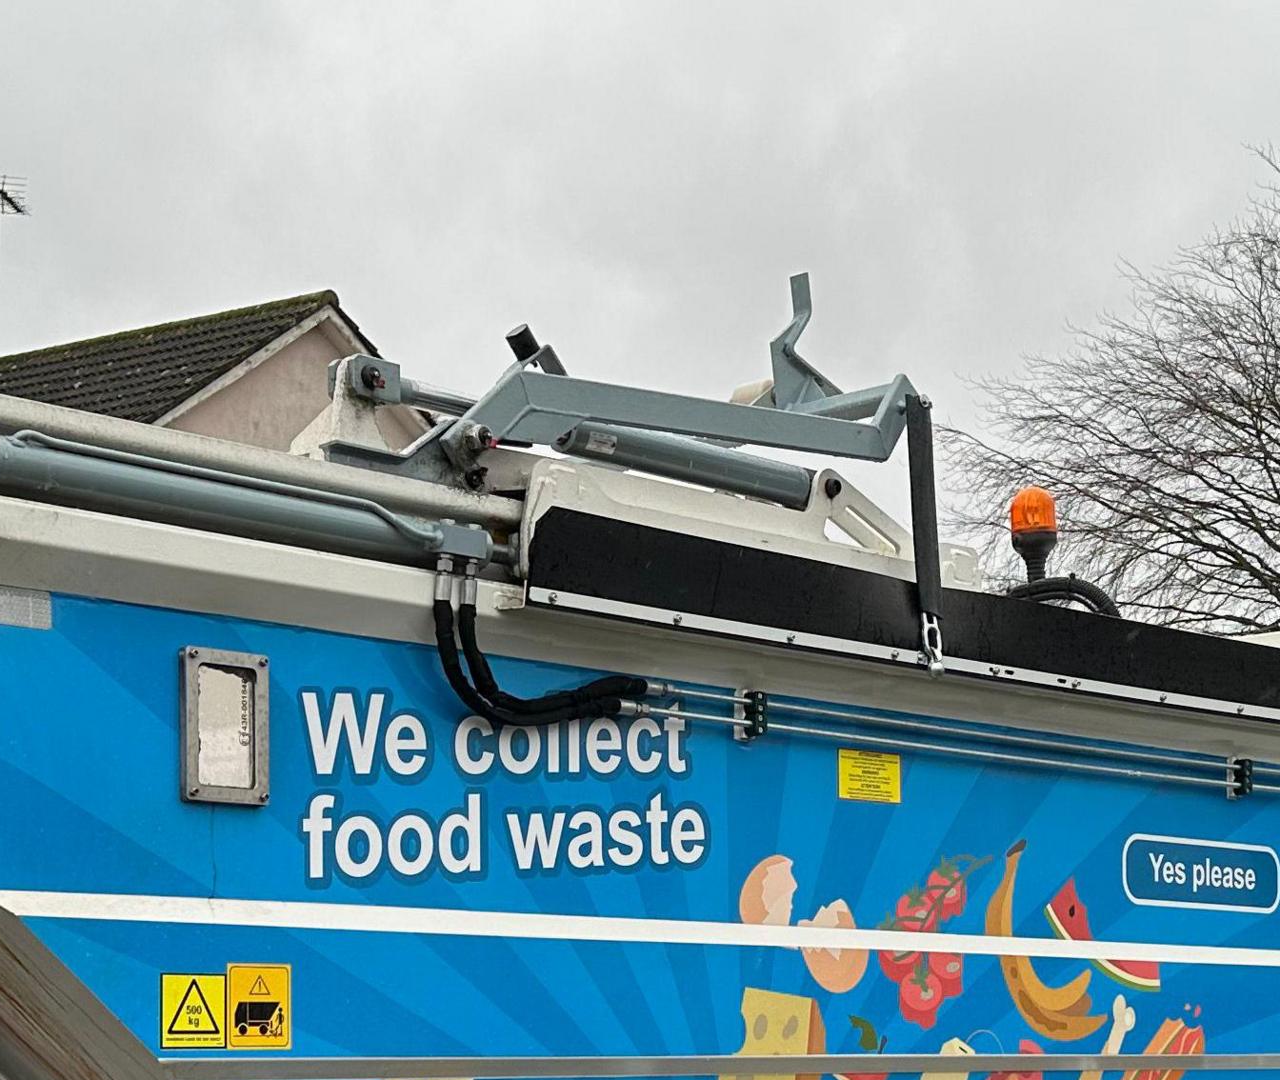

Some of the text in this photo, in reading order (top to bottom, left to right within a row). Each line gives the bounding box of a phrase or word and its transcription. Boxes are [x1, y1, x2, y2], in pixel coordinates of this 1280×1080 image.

[302, 692, 688, 775] We collect
[302, 792, 706, 879] food waste
[1149, 853, 1256, 892] Yes please
[186, 1005, 202, 1015] 500
[188, 1016, 200, 1028] kg
